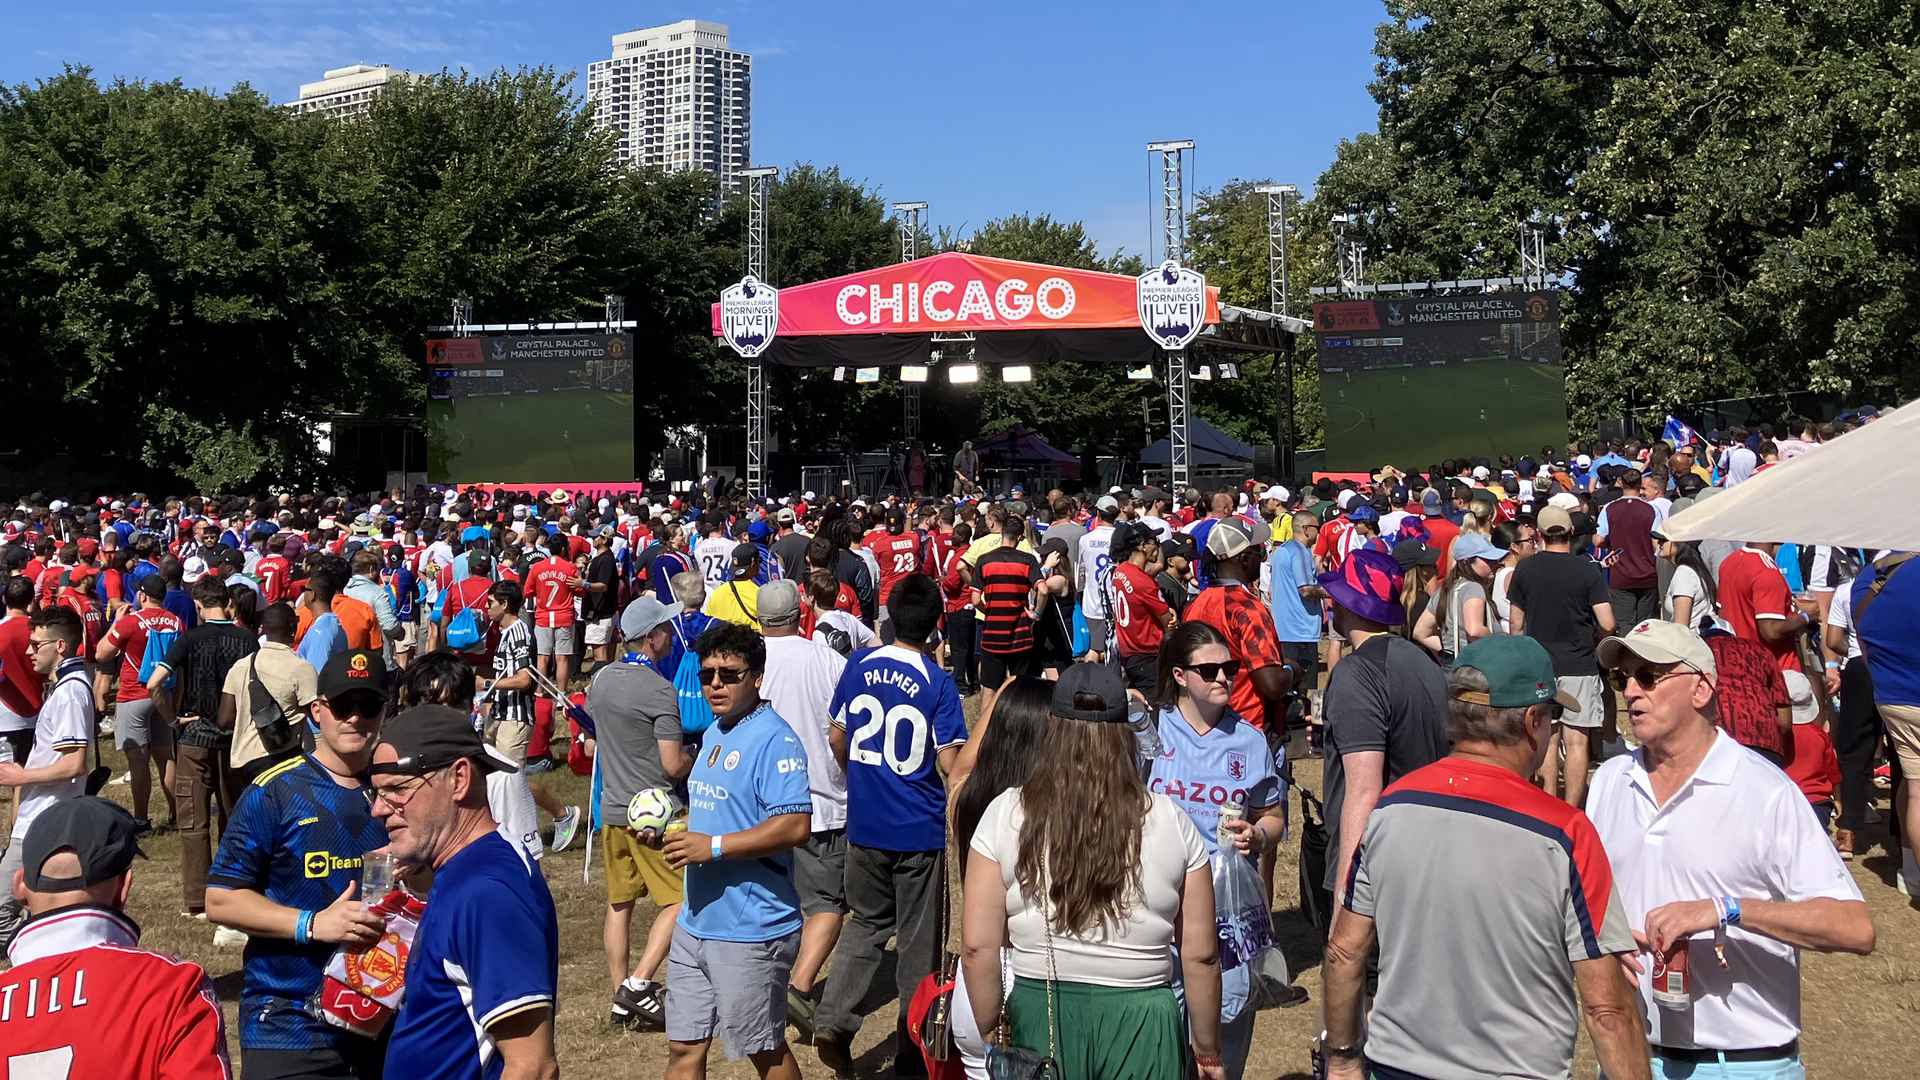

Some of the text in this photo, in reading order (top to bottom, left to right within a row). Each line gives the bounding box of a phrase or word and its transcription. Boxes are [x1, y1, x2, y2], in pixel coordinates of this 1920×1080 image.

[835, 277, 1076, 326] CHICAGO
[1142, 294, 1200, 302] MORNINGS
[1415, 302, 1461, 312] CRYSTAL
[1463, 301, 1503, 310] PALACE
[1156, 303, 1187, 315] LIVE
[1409, 310, 1522, 322] MANCHESTER UNITED
[736, 315, 763, 326] LIVE
[516, 341, 555, 349] CRYSTAL
[556, 340, 590, 348] PALACE
[510, 349, 604, 358] MANCHESTER UNITED
[702, 554, 724, 581] 23
[893, 552, 915, 573] 23
[263, 571, 274, 593] 7
[545, 580, 560, 608] 7
[863, 668, 920, 699] PALMER
[848, 693, 928, 776] 20
[688, 780, 729, 800] TIHAD
[329, 856, 364, 870] Team
